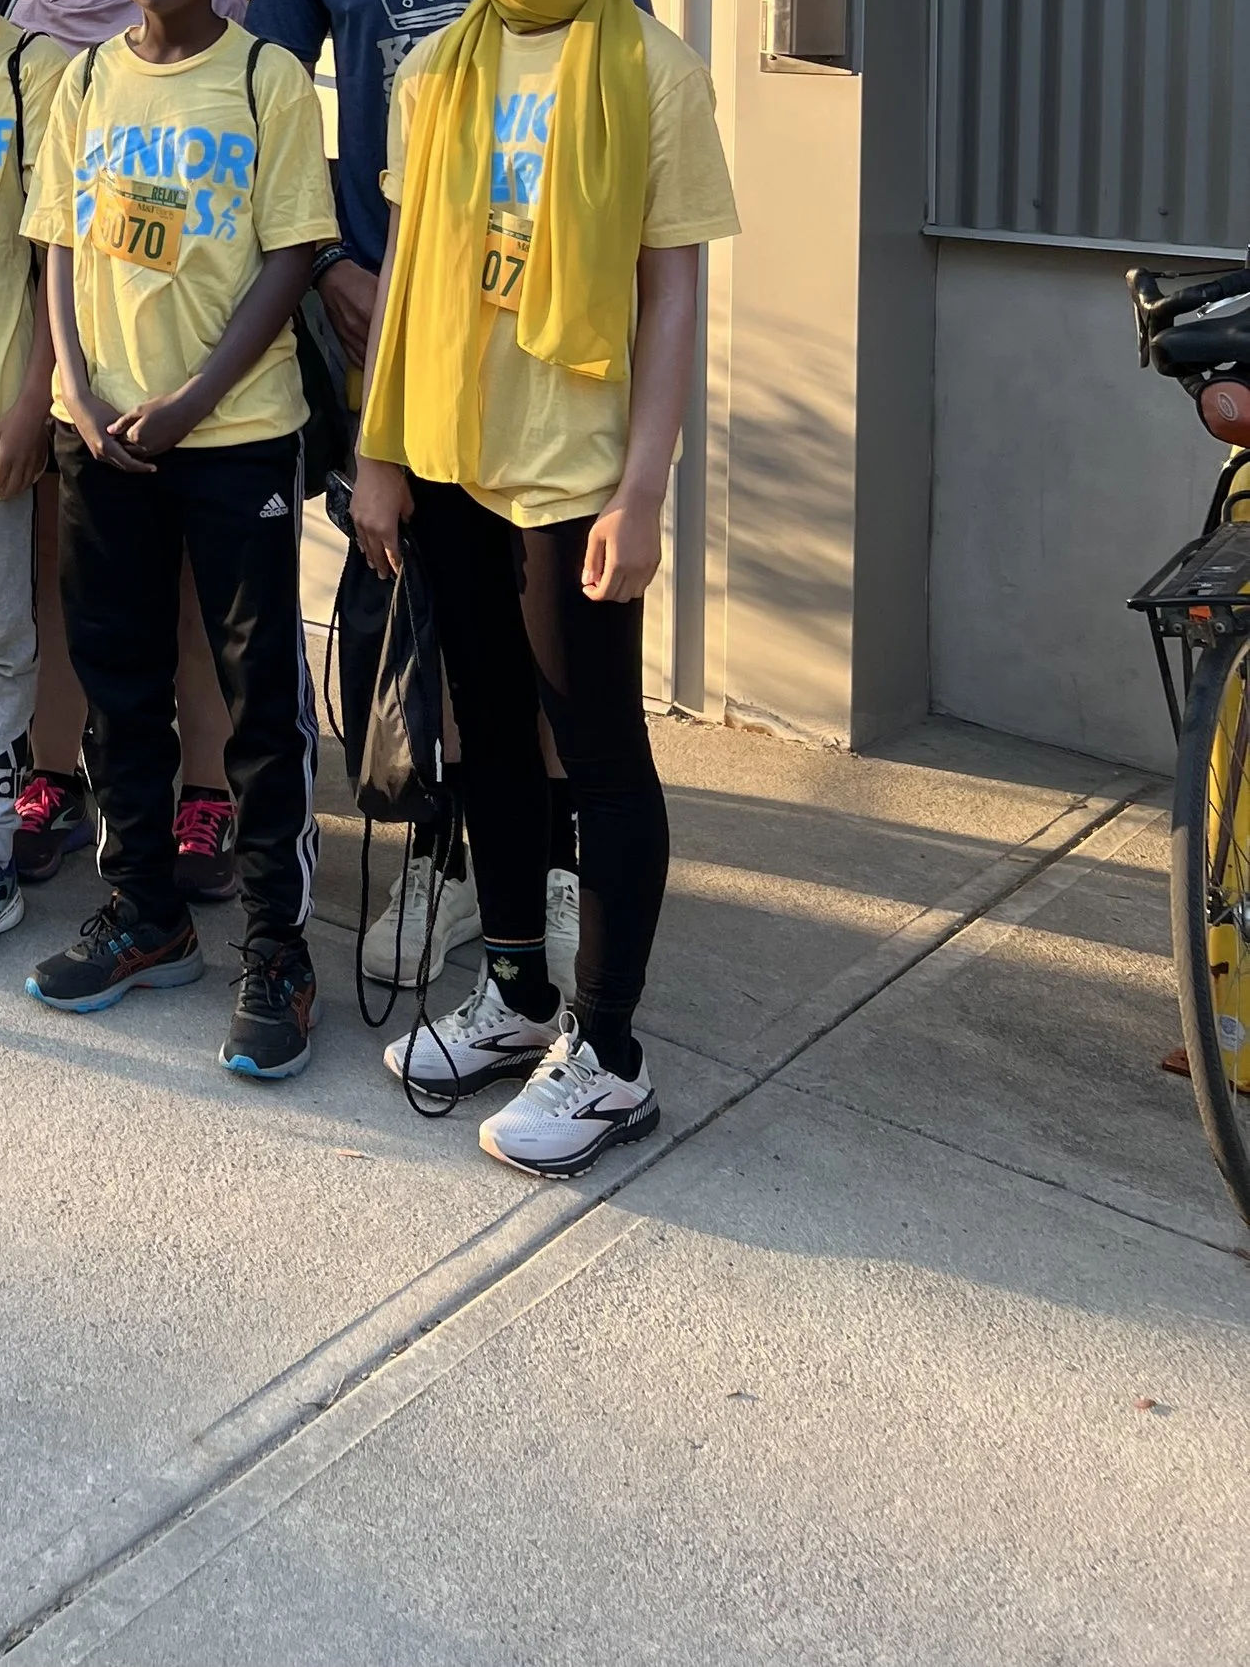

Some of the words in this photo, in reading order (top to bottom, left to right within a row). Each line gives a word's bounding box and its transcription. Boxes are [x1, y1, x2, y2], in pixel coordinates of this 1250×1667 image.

[151, 186, 179, 203] RELAY
[481, 249, 526, 297] 07
[259, 506, 289, 518] adida
